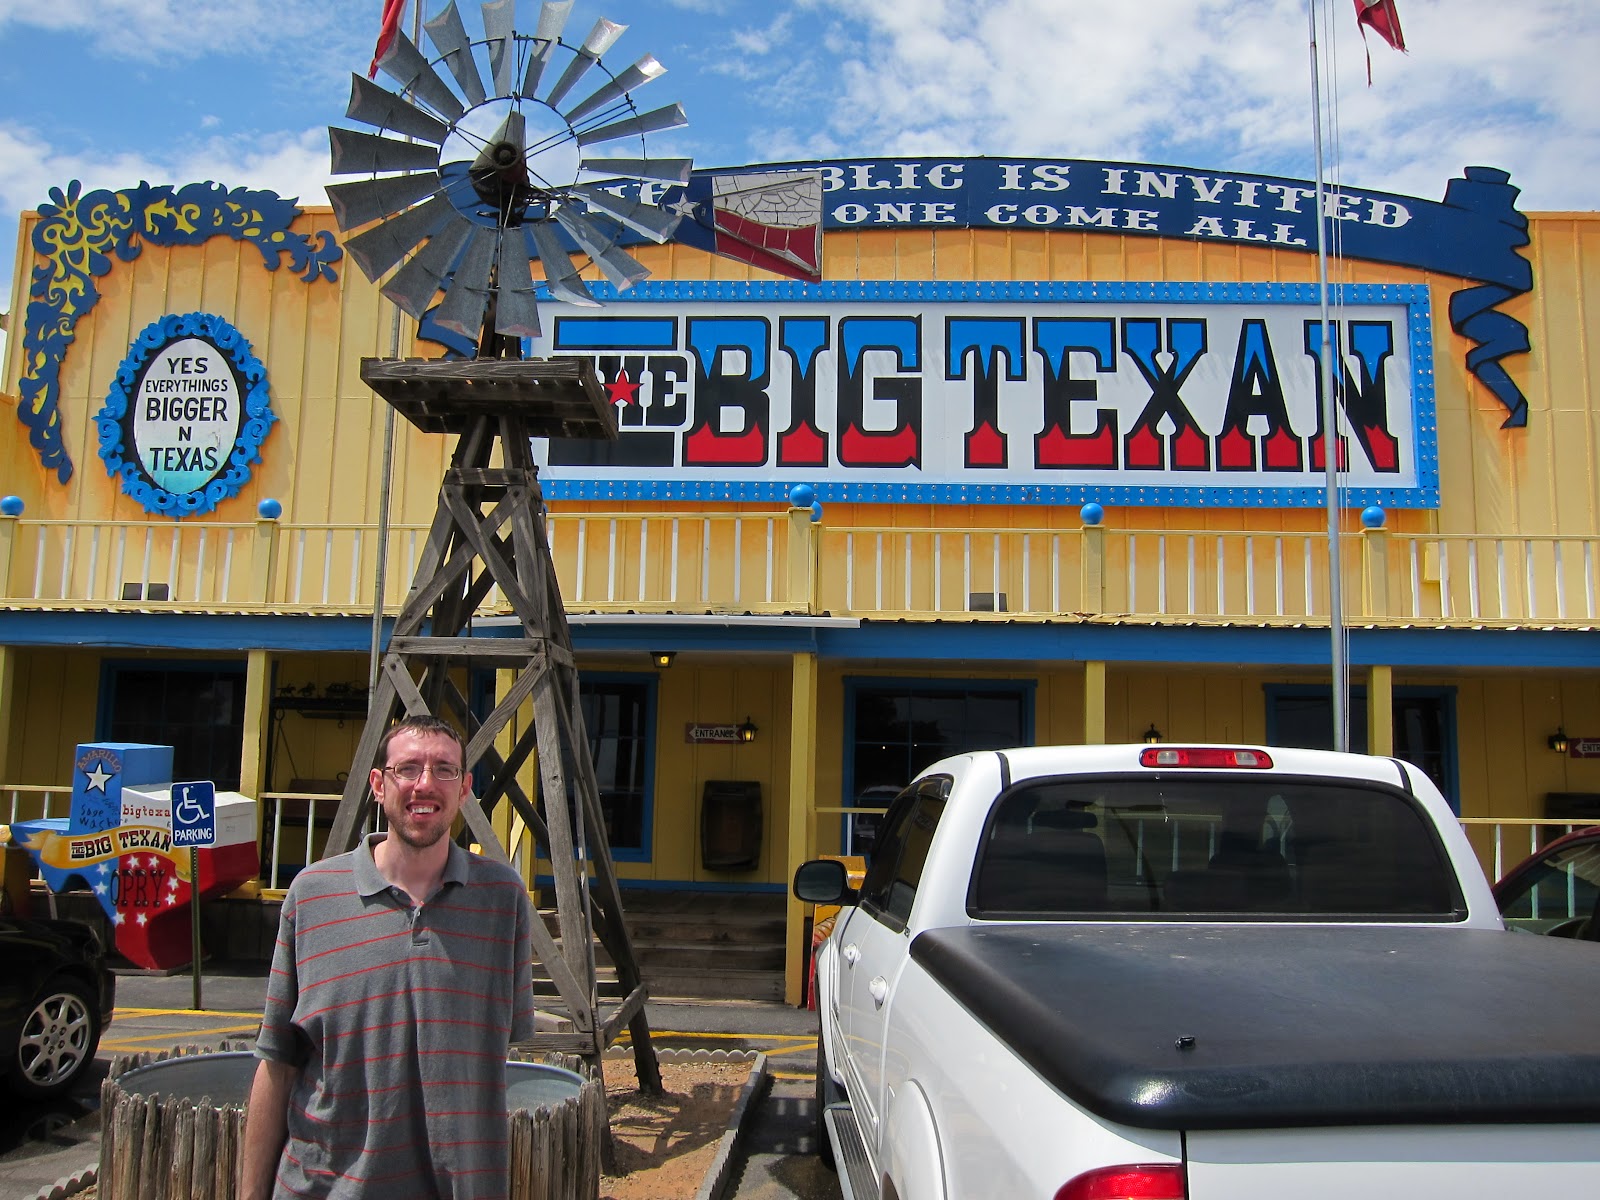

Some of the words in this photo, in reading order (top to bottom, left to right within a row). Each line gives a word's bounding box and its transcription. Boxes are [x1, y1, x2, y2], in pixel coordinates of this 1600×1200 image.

[821, 163, 965, 192] BLIC
[998, 164, 1071, 193] IS
[1100, 167, 1413, 229] INVITED
[830, 202, 958, 225] ONE
[984, 204, 1159, 231] COME
[1183, 215, 1308, 247] ALL
[167, 357, 209, 375] YES
[145, 379, 228, 393] EVERYTHINGS
[682, 313, 923, 471] BIG
[944, 316, 1401, 474] TEXAN
[146, 397, 228, 422] BIGGER
[178, 426, 192, 441] N
[149, 446, 218, 472] TEXAS
[695, 729, 733, 738] ENTRANCE
[77, 750, 122, 773] AMARILLO
[84, 836, 112, 858] BIG
[119, 830, 171, 852] TEXAN
[174, 827, 213, 841] PARKING
[110, 868, 165, 907] OPRY
